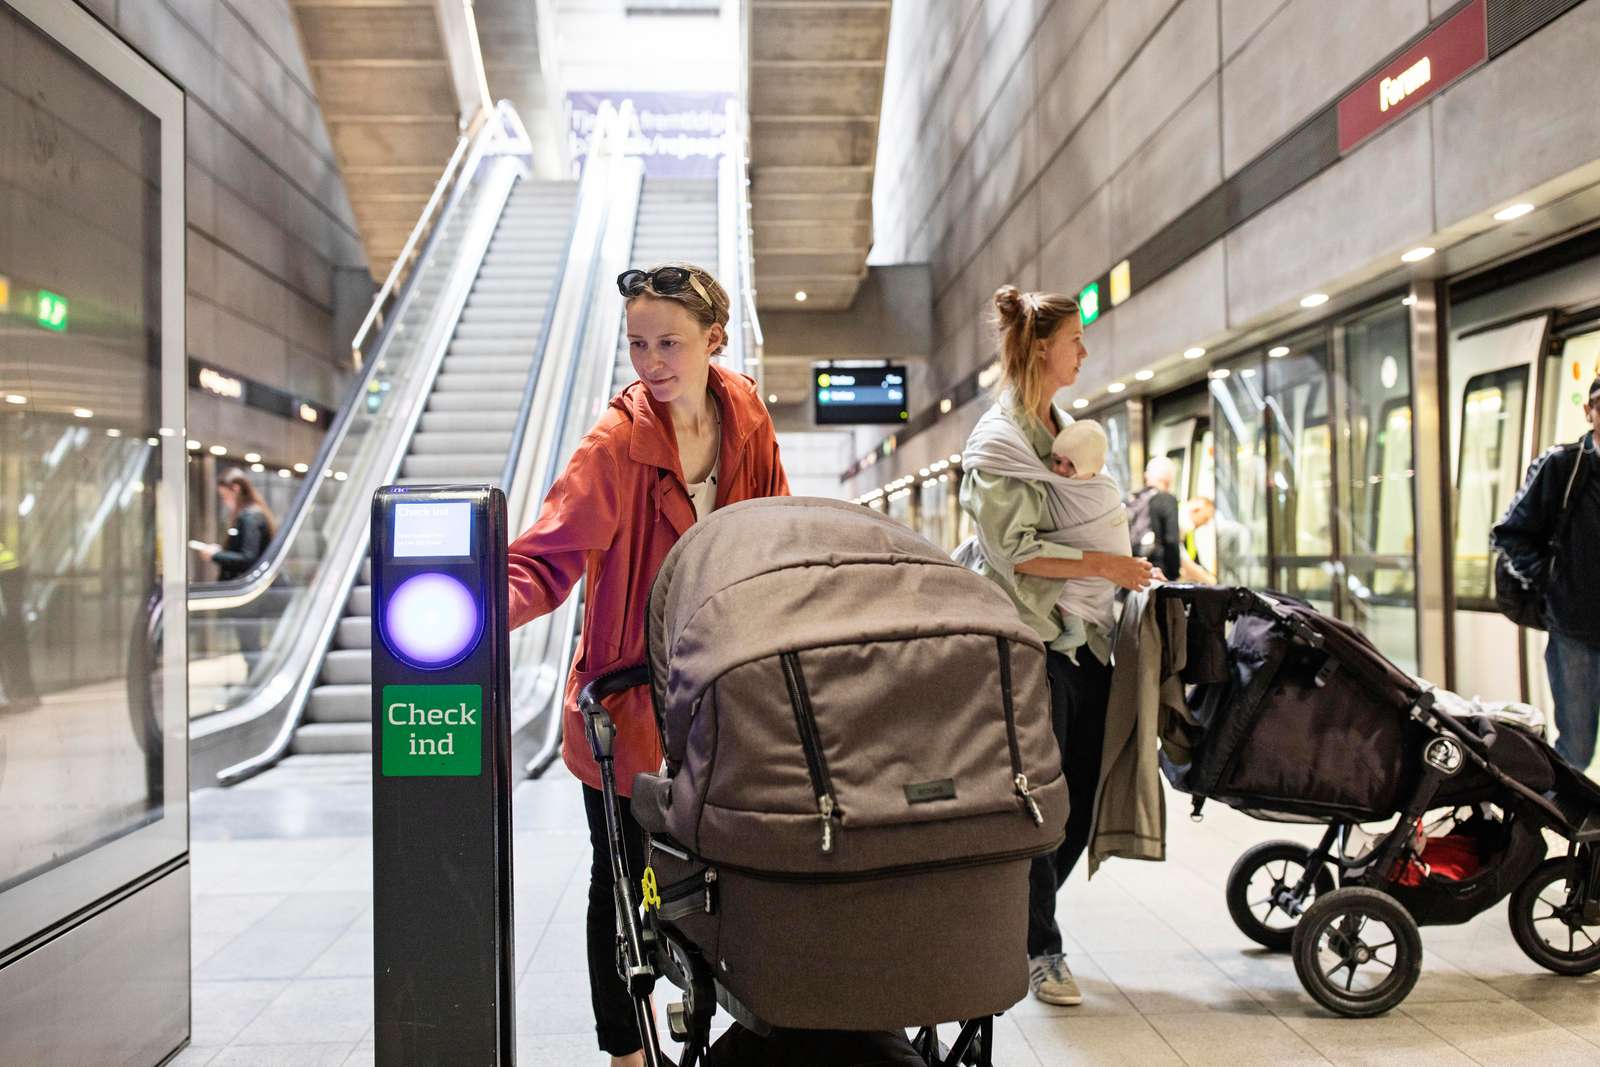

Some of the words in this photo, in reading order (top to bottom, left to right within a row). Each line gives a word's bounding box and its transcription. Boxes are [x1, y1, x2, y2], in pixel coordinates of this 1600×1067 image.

[1379, 56, 1431, 112] Forum
[387, 702, 477, 726] Check
[408, 732, 455, 756] ind
